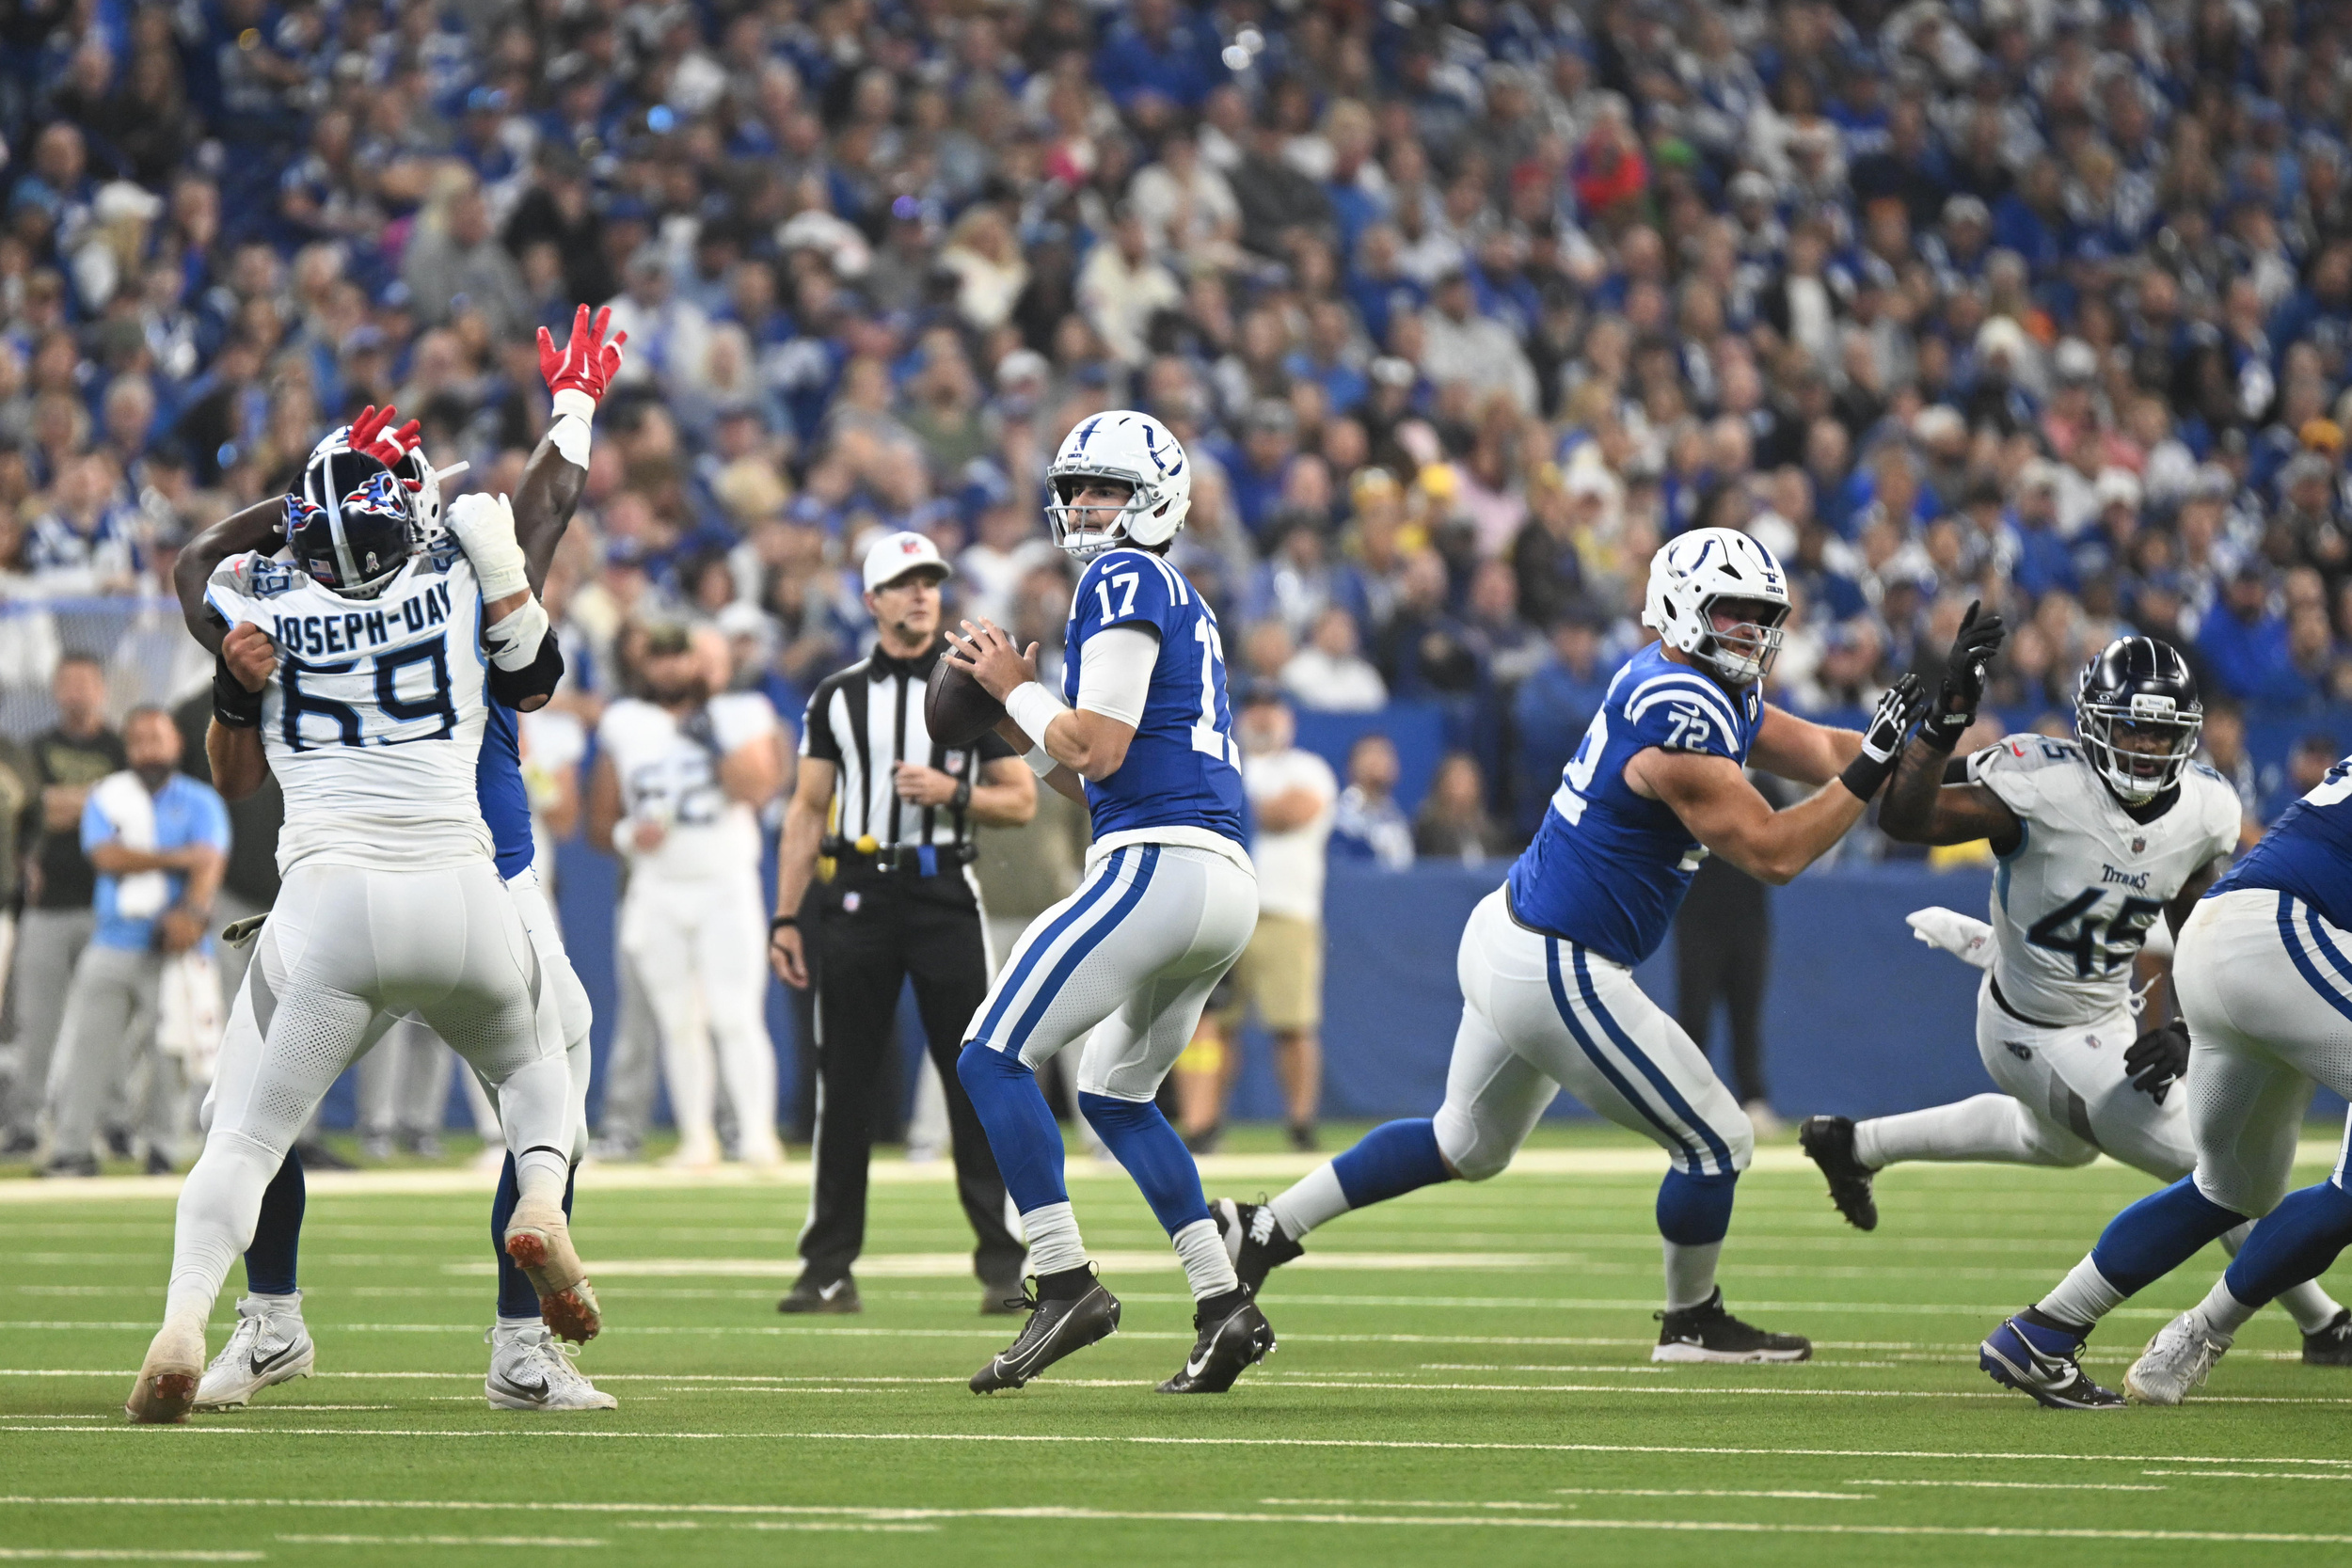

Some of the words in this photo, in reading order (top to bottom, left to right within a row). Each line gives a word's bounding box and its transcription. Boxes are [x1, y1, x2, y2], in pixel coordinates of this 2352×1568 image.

[1095, 571, 1139, 626] 17
[280, 630, 458, 752] 69
[1663, 710, 1710, 753] 72
[2101, 863, 2151, 890] TITANS
[2025, 886, 2166, 979] 45
